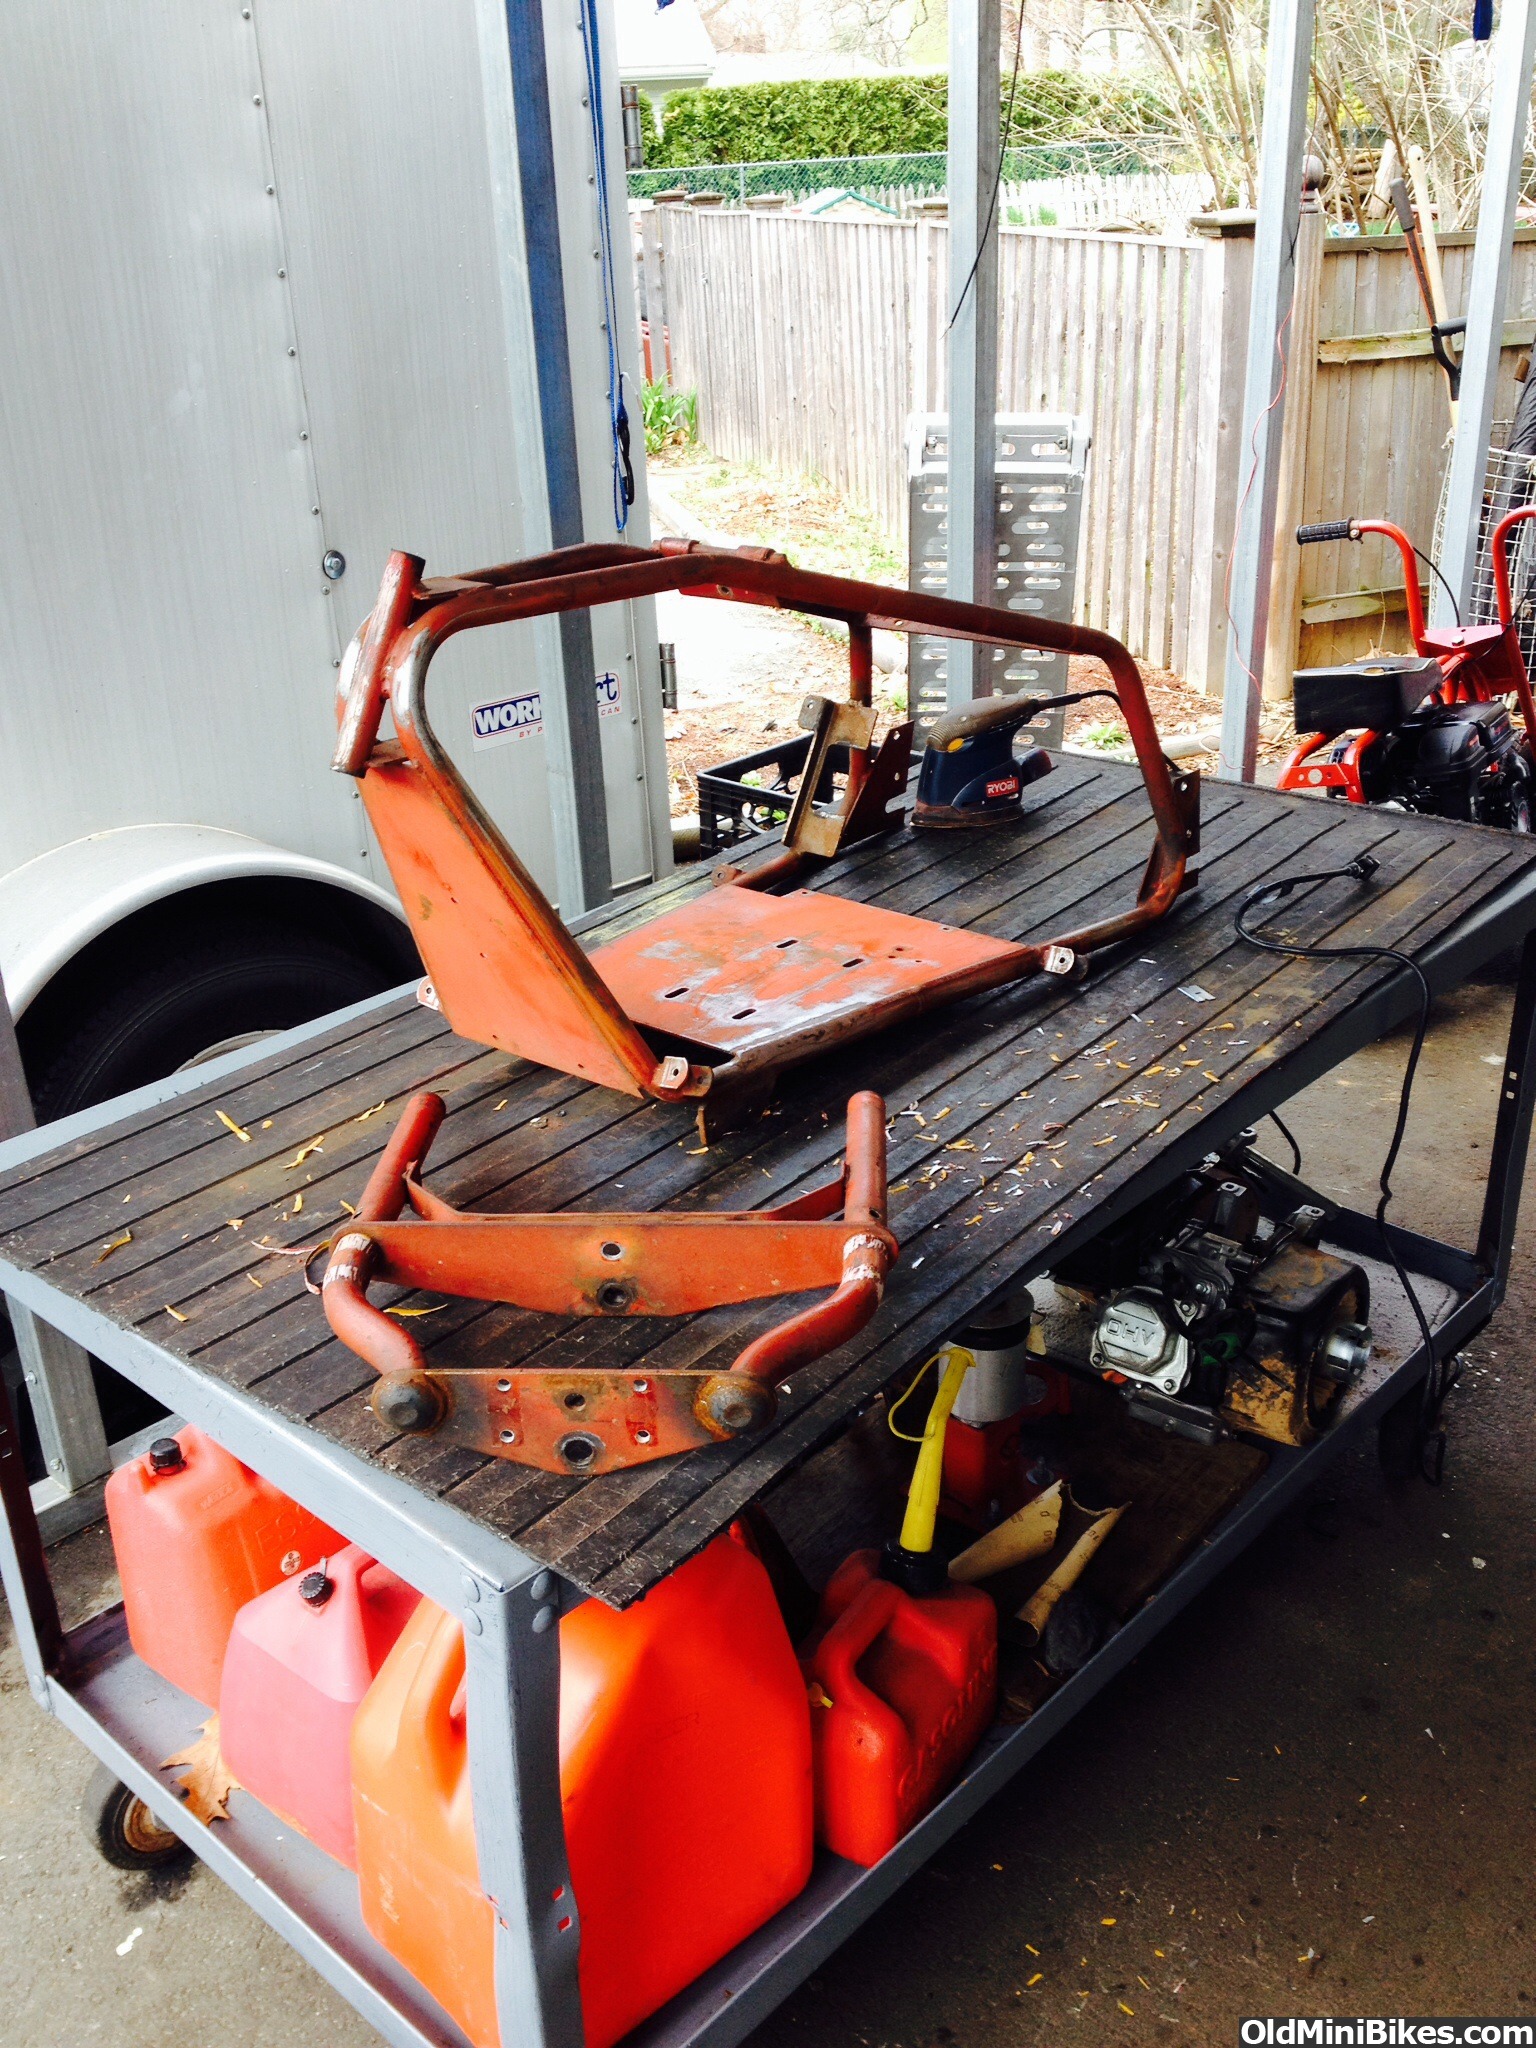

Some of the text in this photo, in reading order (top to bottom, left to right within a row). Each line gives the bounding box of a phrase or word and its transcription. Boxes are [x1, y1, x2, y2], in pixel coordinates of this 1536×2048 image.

[600, 706, 620, 716] CAN
[986, 779, 1016, 794] RYOBI
[1106, 1317, 1155, 1346] OHV
